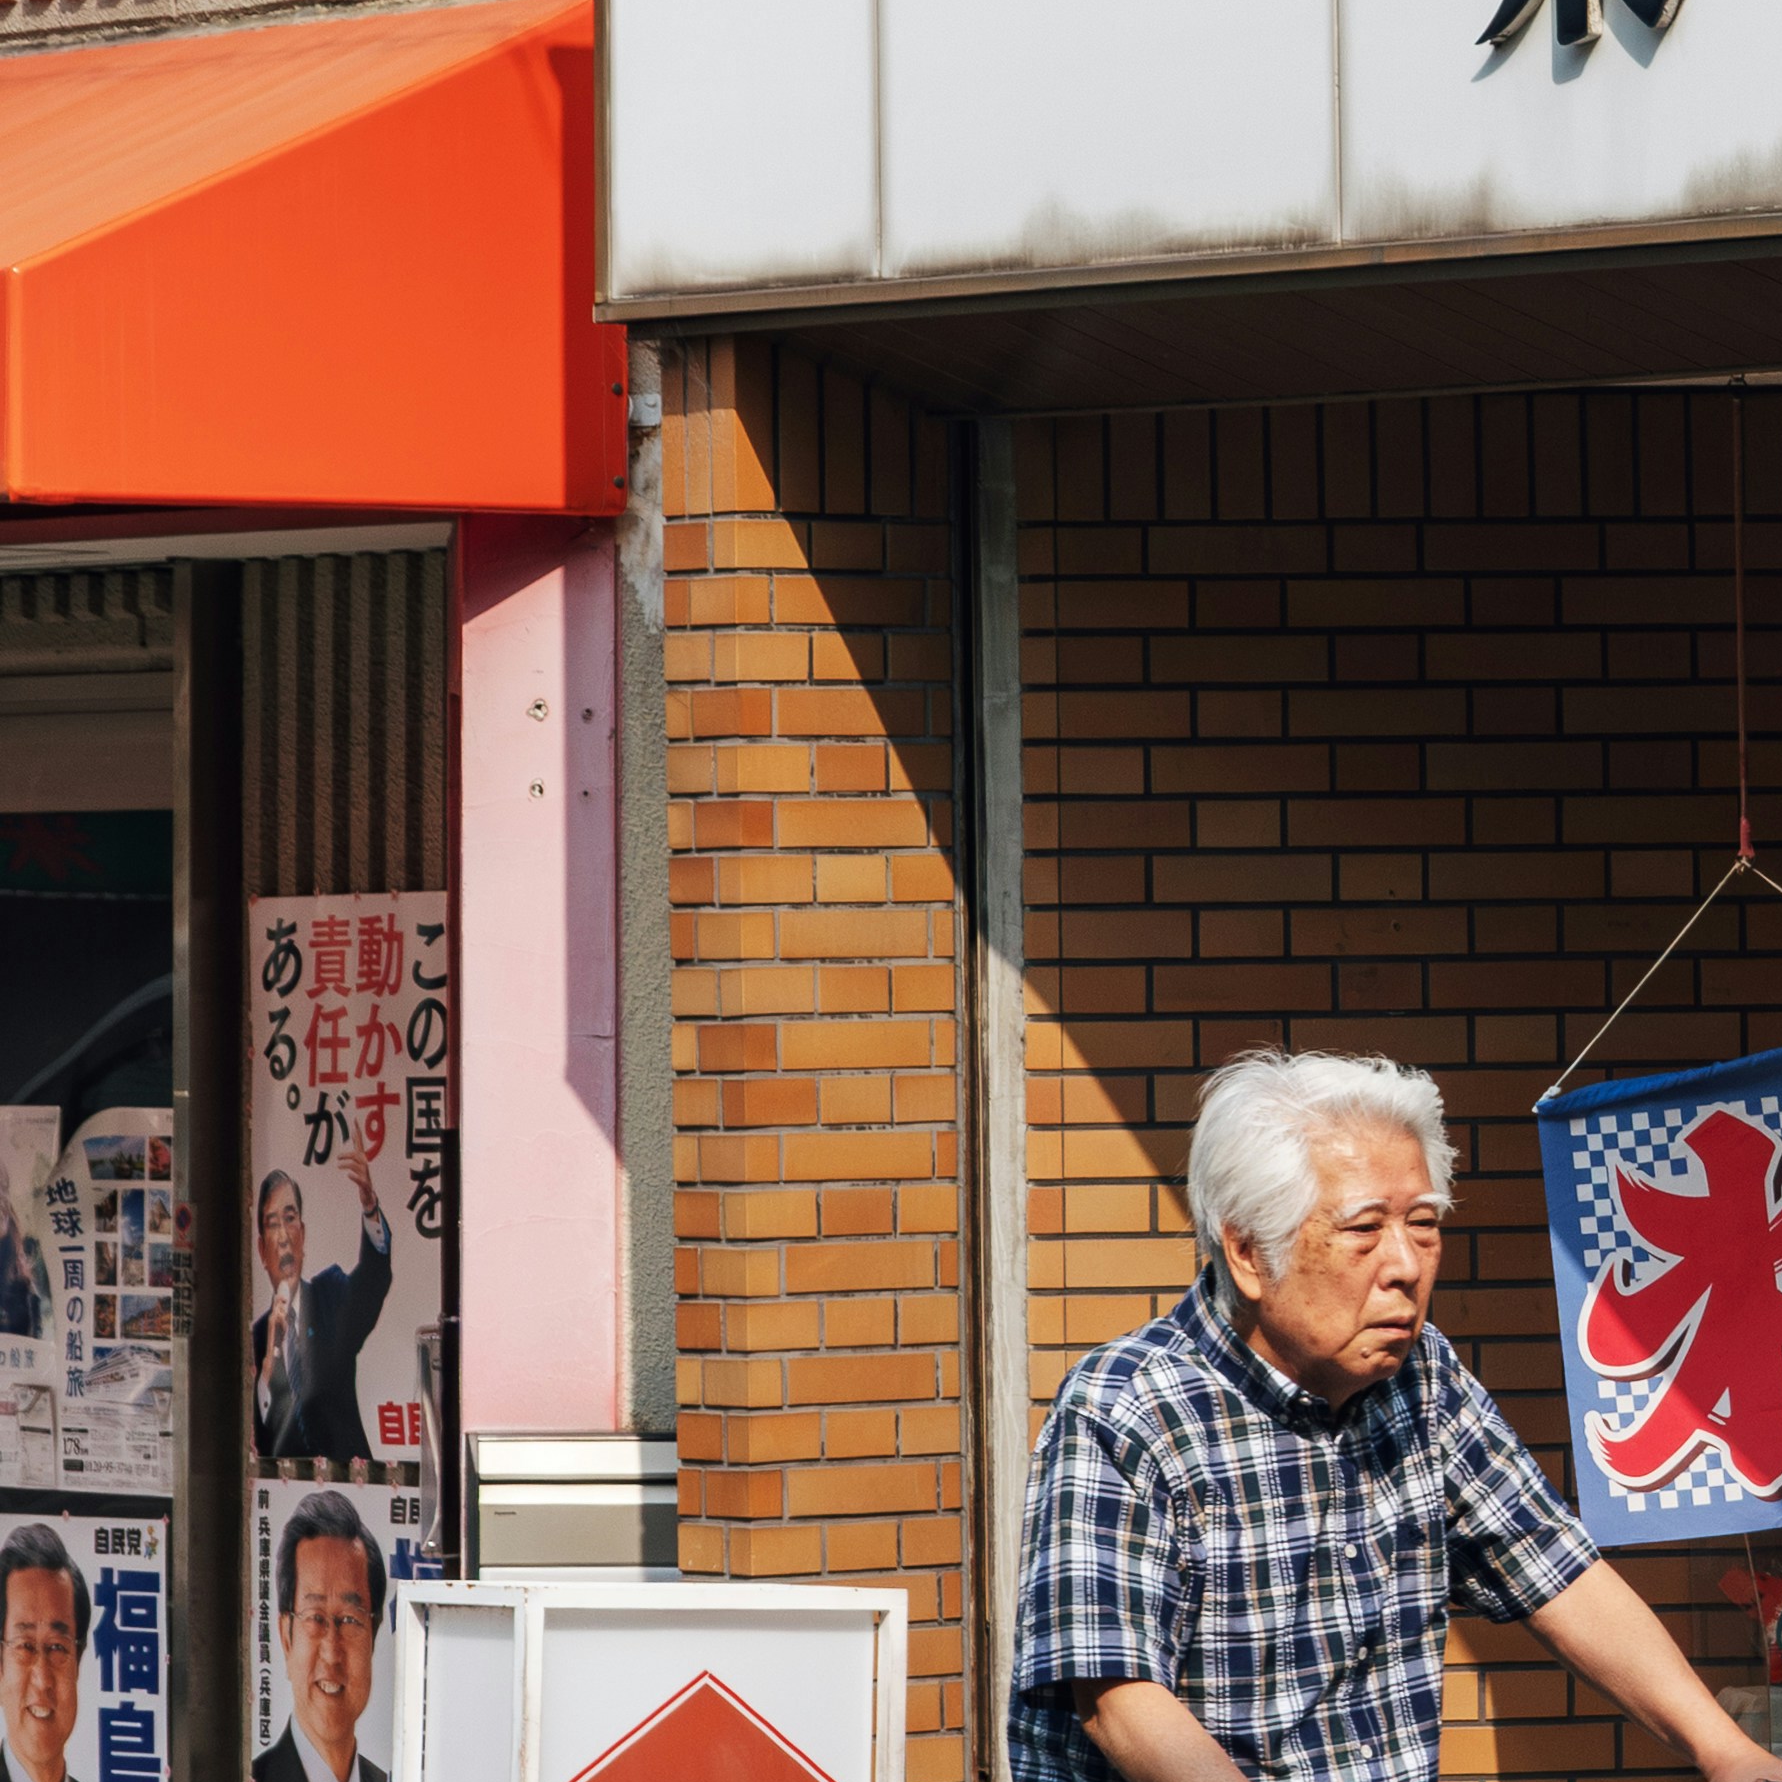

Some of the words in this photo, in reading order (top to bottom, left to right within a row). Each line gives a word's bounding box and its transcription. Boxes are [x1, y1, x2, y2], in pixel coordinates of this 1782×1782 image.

[262, 918, 303, 1111] ある。
[303, 914, 353, 1167] 責任が
[354, 912, 404, 1163] 動かす
[406, 922, 448, 1240] この国を
[46, 1176, 85, 1398] 地球一周の船旅
[94, 1527, 142, 1555] 自民党
